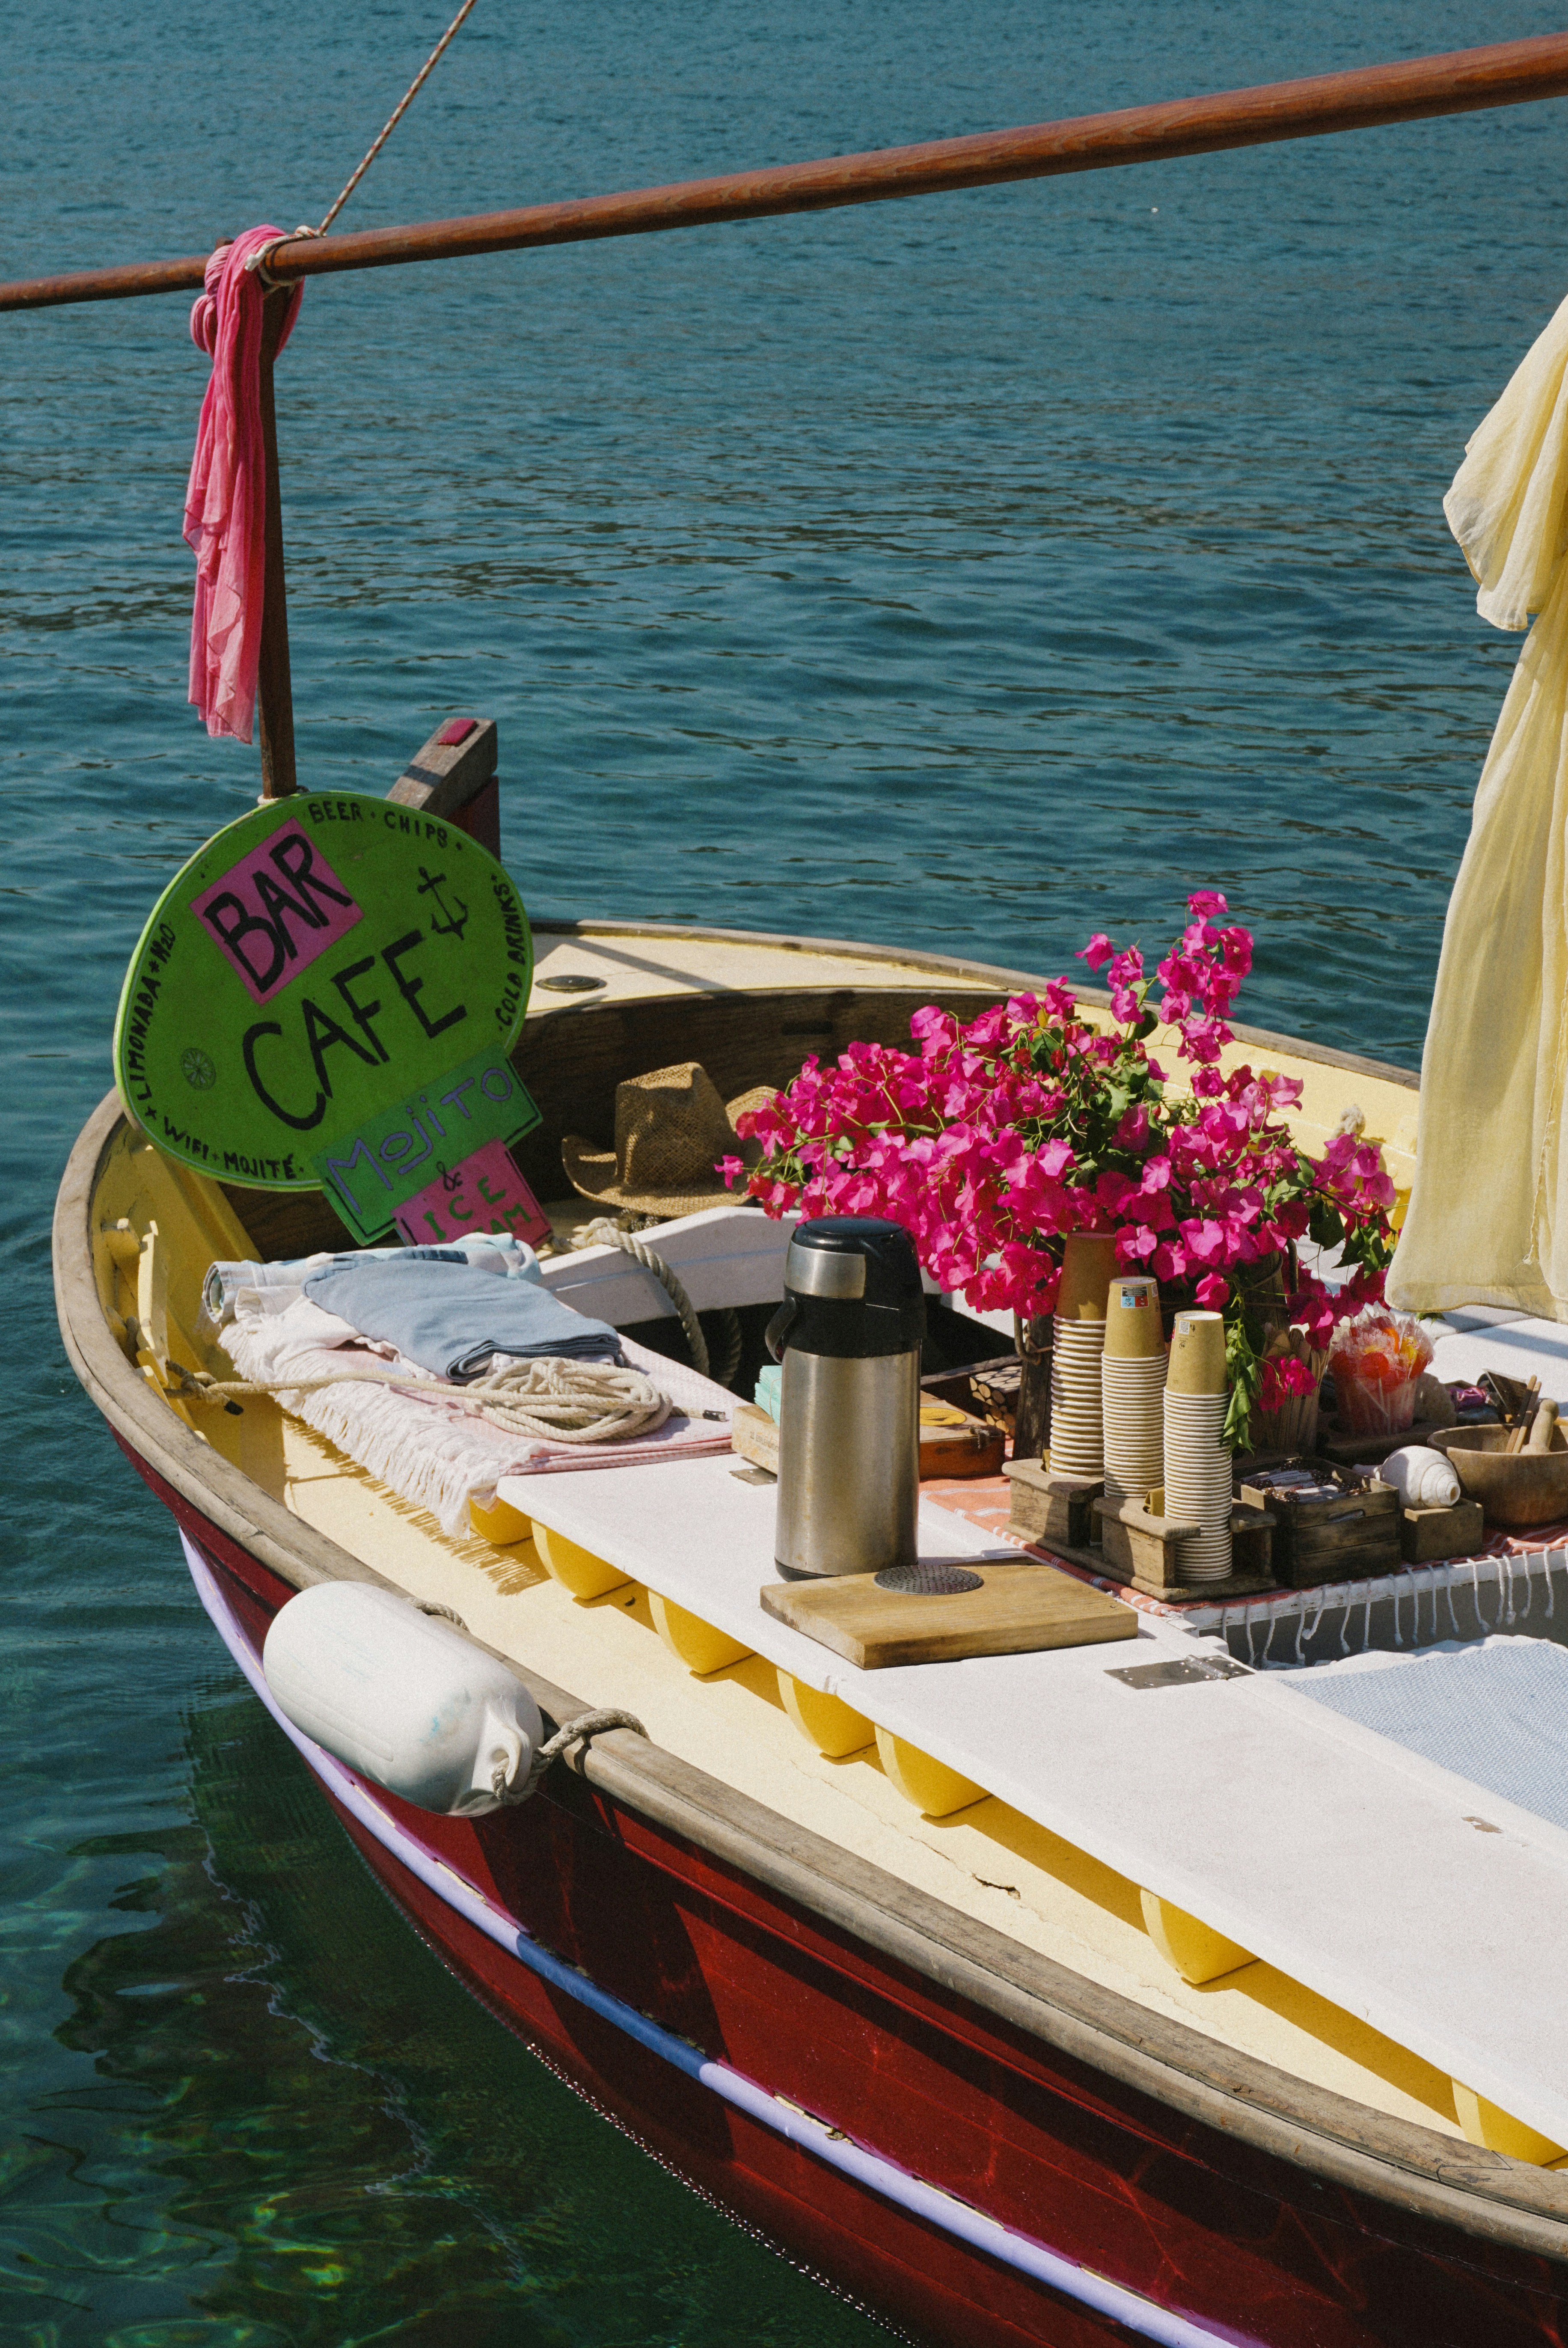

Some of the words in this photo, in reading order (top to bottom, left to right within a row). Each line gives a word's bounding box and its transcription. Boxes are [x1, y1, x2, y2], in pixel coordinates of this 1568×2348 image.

[308, 800, 363, 824] BEER
[384, 811, 448, 848] CHIPS
[203, 834, 353, 994] BAR
[493, 883, 526, 966] DRINKS
[242, 929, 467, 1131] CAFE
[495, 972, 523, 1026] COLD
[128, 975, 161, 1101] LIMONADA
[163, 1116, 209, 1160] WIFI
[423, 1175, 506, 1242] ICE
[436, 1160, 463, 1192] &
